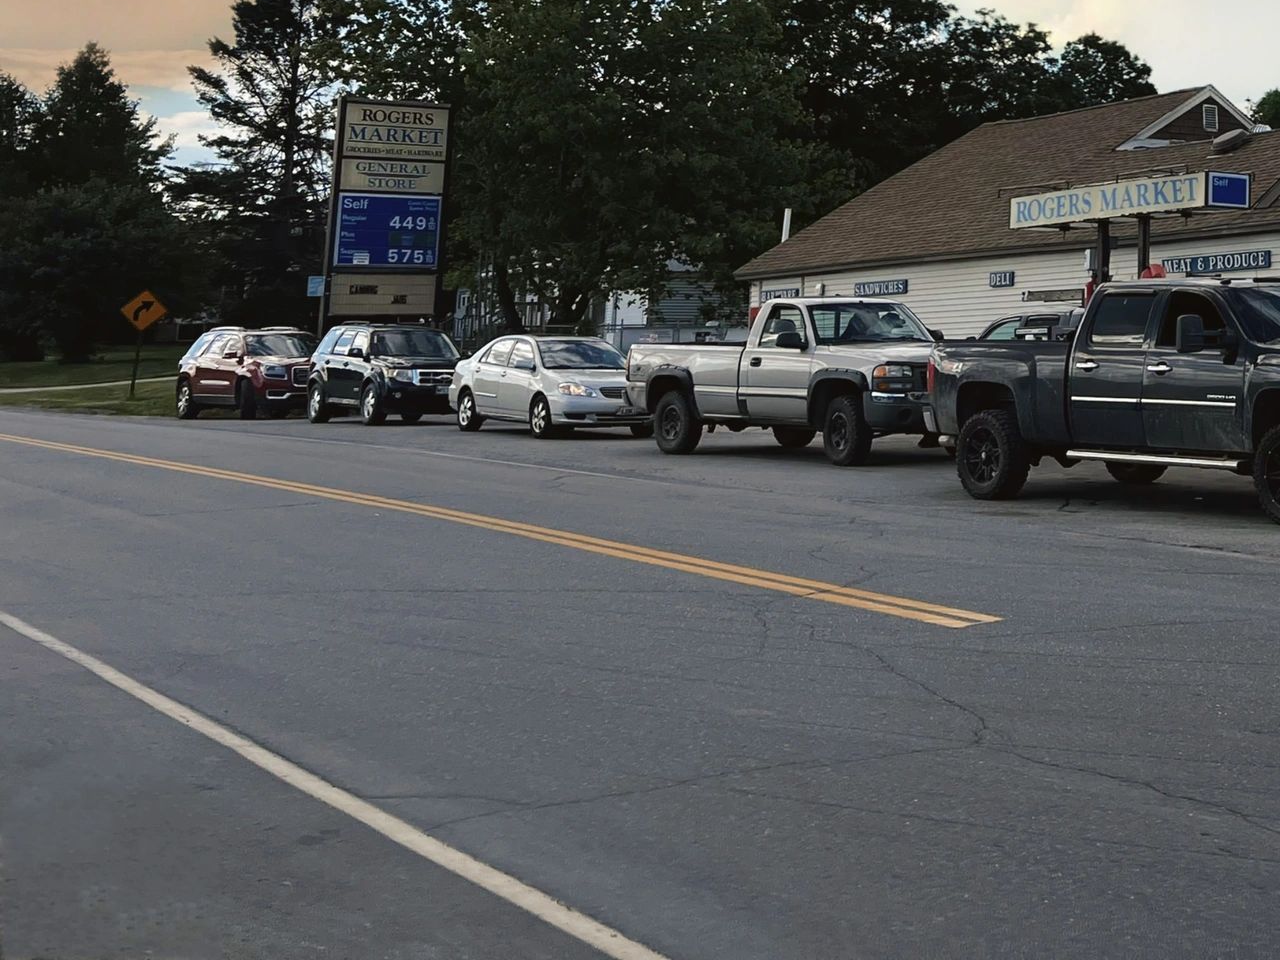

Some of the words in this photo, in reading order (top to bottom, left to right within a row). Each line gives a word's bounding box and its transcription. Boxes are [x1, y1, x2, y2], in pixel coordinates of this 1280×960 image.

[361, 109, 434, 125] ROGERS
[350, 126, 443, 144] MARKET
[345, 145, 382, 154] GROCERIES
[385, 148, 403, 156] MEAT
[356, 161, 430, 175] GENERAL
[368, 178, 416, 189] STORE
[1213, 176, 1229, 188] Self
[344, 198, 369, 209] Self
[1015, 191, 1092, 224] ROGERS
[1099, 176, 1200, 211] MARKET
[390, 216, 426, 230] 449
[388, 248, 424, 264] 575
[1163, 257, 1192, 273] MEAT
[1197, 257, 1205, 271] &
[1209, 251, 1266, 270] PRODUCE
[990, 273, 1011, 287] DELI
[855, 280, 904, 297] SANDWICHES
